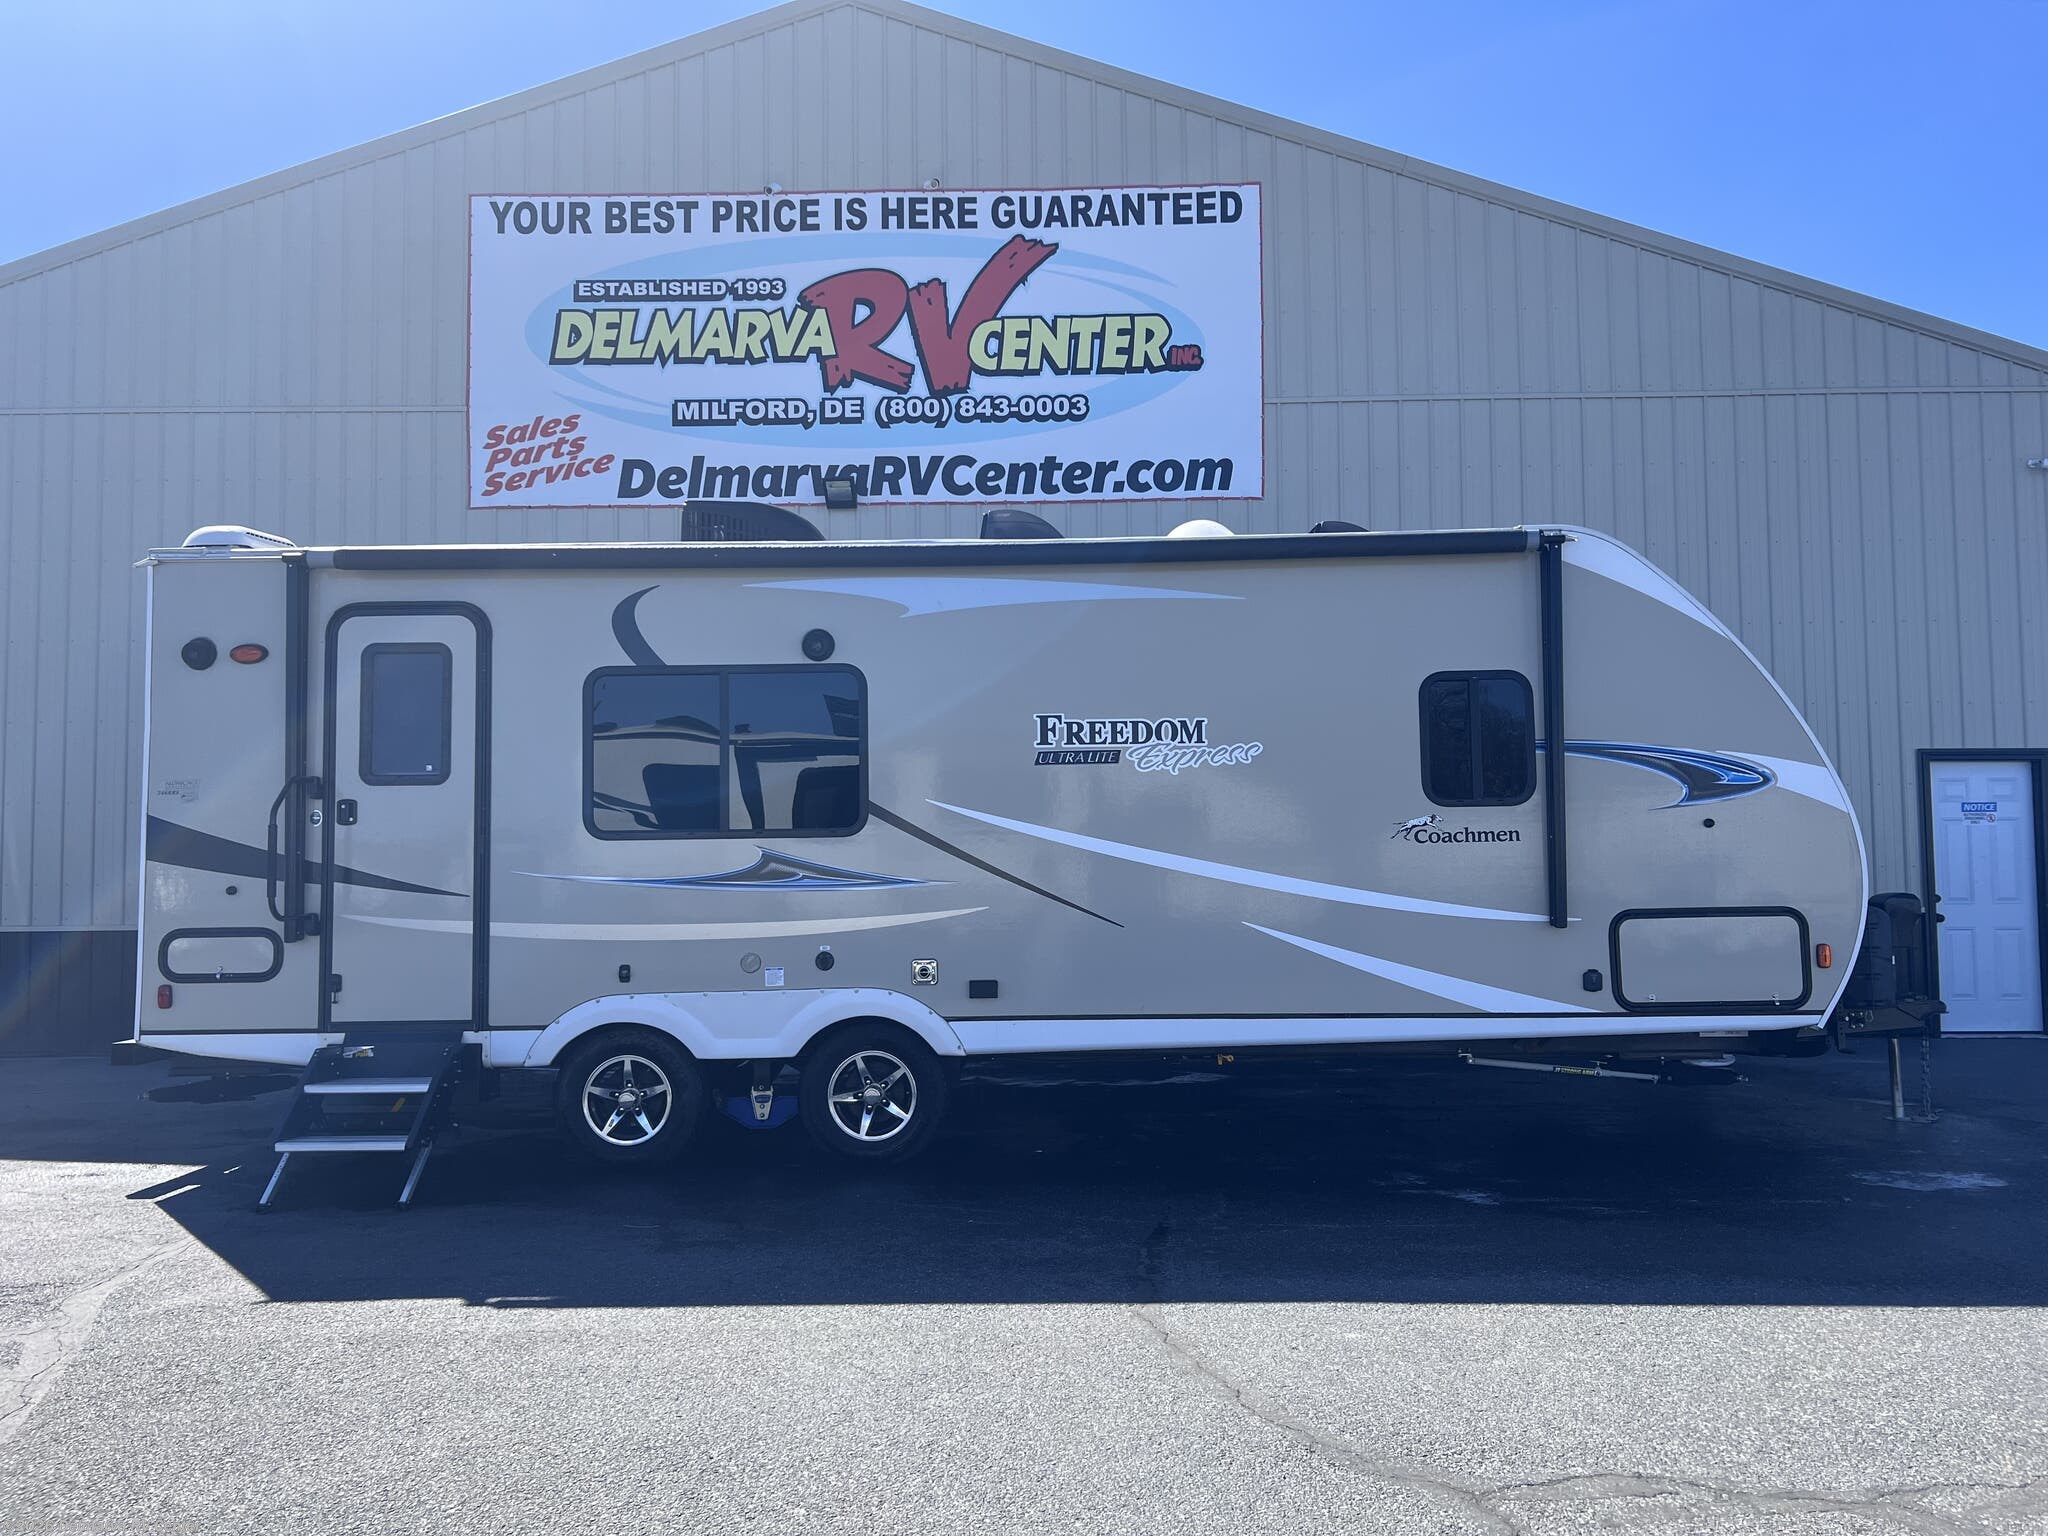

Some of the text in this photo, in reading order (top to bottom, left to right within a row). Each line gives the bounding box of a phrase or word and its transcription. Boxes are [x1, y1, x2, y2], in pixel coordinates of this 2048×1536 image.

[489, 190, 1243, 235] YOUR BEST PRICE IS HERE GUARANTEED
[577, 280, 784, 297] ESTABLISHED 1993
[551, 307, 838, 363] DELMARVA
[797, 233, 1060, 397] RV
[968, 313, 1173, 374] CENTER
[675, 396, 1088, 426] MILFORD, DE (800) 843-0003
[482, 414, 582, 450] Sales
[485, 436, 588, 474] Parts
[481, 454, 616, 497] Service
[616, 455, 1234, 499] DelmarvaRVCenter.com
[1126, 741, 1263, 775] Express
[1963, 803, 1996, 811] NOTICE
[1413, 826, 1521, 844] Coachmen
